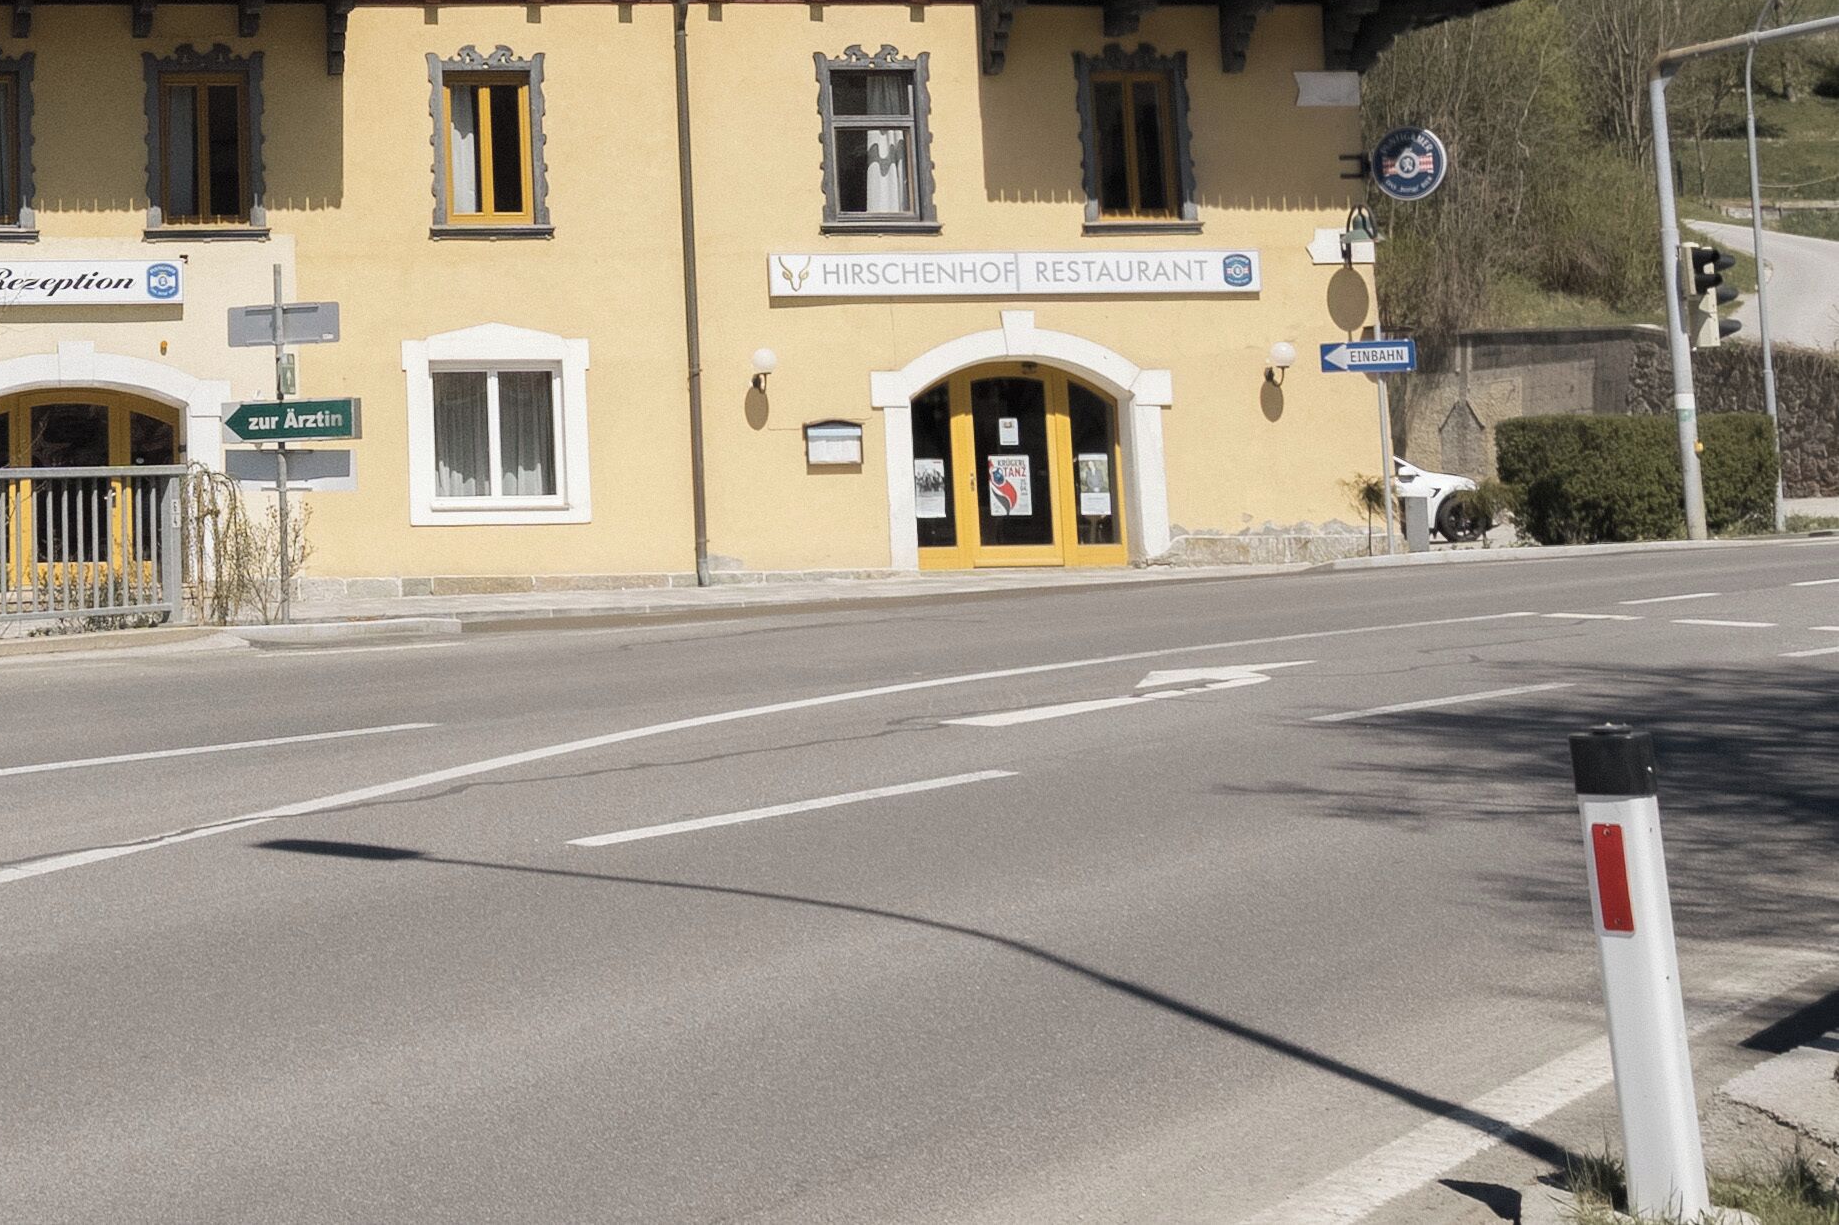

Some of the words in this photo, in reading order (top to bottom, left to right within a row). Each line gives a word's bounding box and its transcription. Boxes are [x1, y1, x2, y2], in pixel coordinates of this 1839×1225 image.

[822, 261, 1015, 285] HIRSCHENHOF
[1035, 260, 1208, 283] RESTAURANT
[1350, 349, 1404, 363] EINBAHN
[248, 416, 279, 430] zur
[283, 408, 343, 429] Ärztin
[1003, 466, 1027, 477] TANZ
